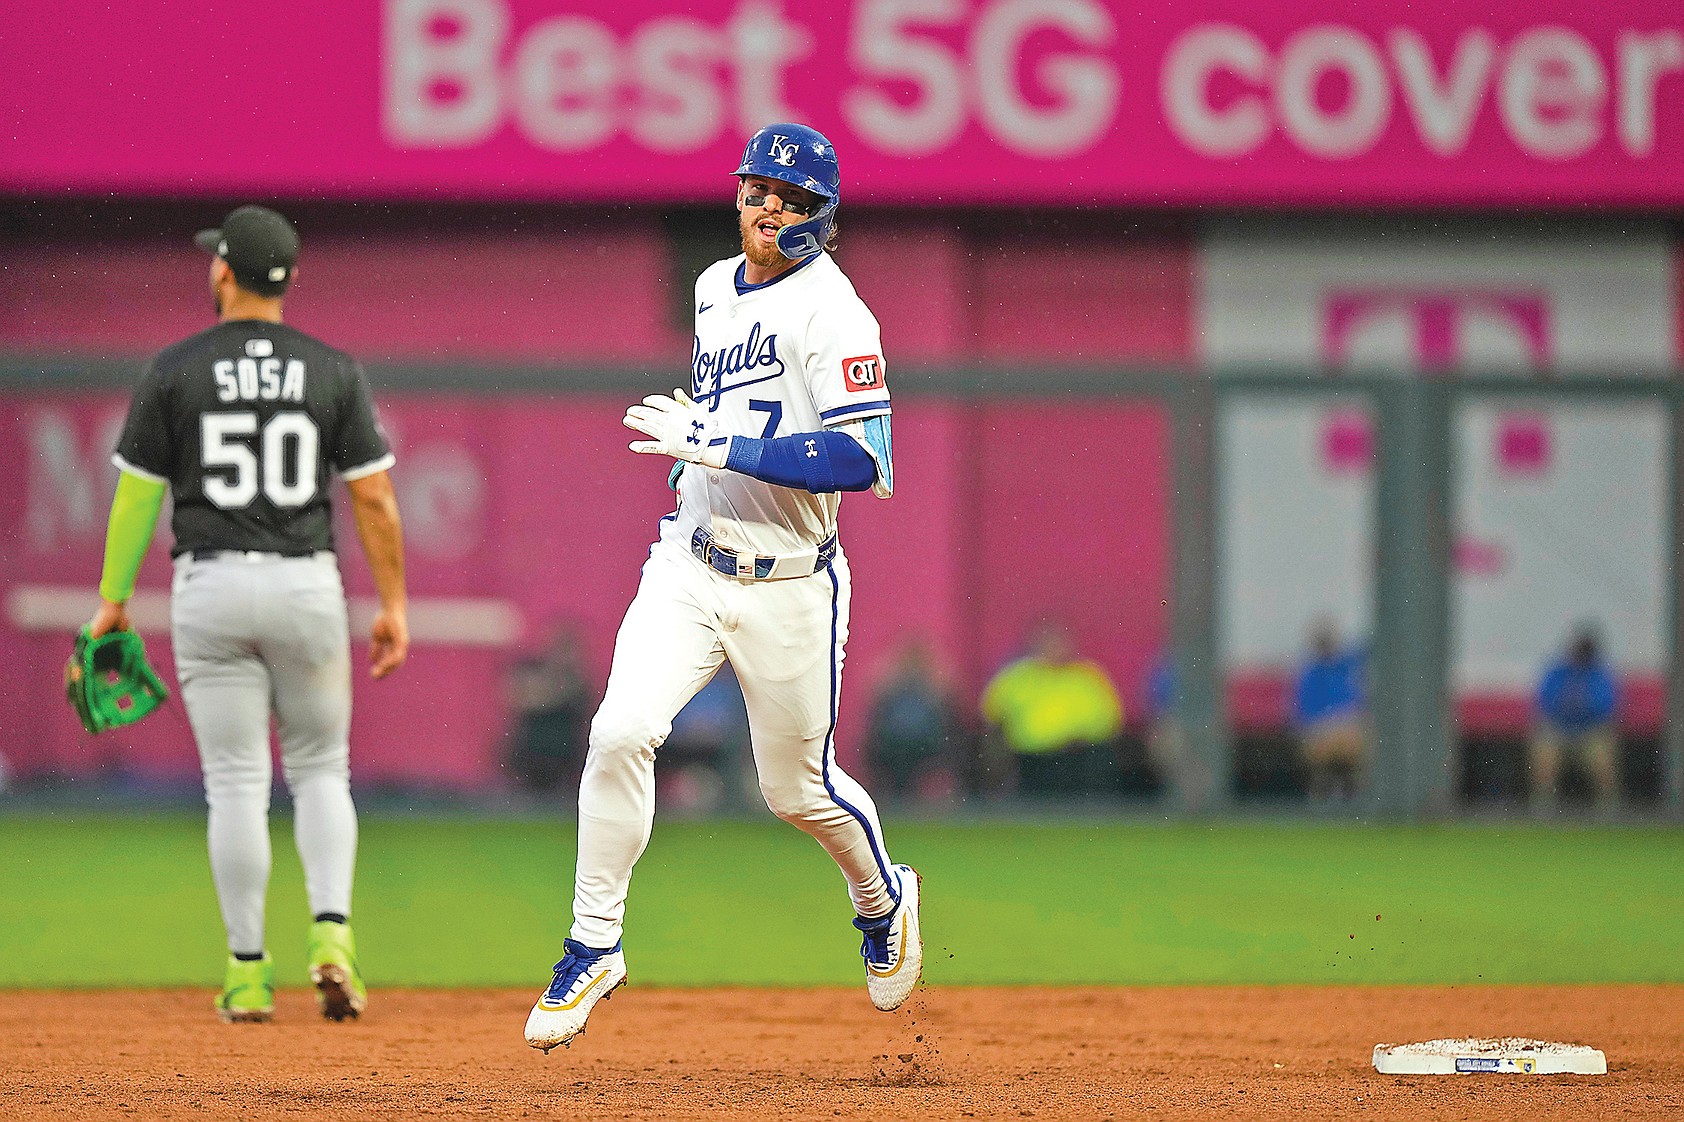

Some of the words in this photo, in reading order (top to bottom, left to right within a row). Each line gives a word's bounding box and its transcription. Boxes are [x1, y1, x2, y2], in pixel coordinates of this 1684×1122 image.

[382, 0, 813, 154] Best
[842, 0, 1118, 158] 5G
[1160, 22, 1683, 160] cover
[768, 134, 799, 167] KC
[213, 357, 307, 403] SOSA
[848, 359, 878, 387] QT
[749, 399, 782, 439] 7
[200, 411, 320, 509] 50
